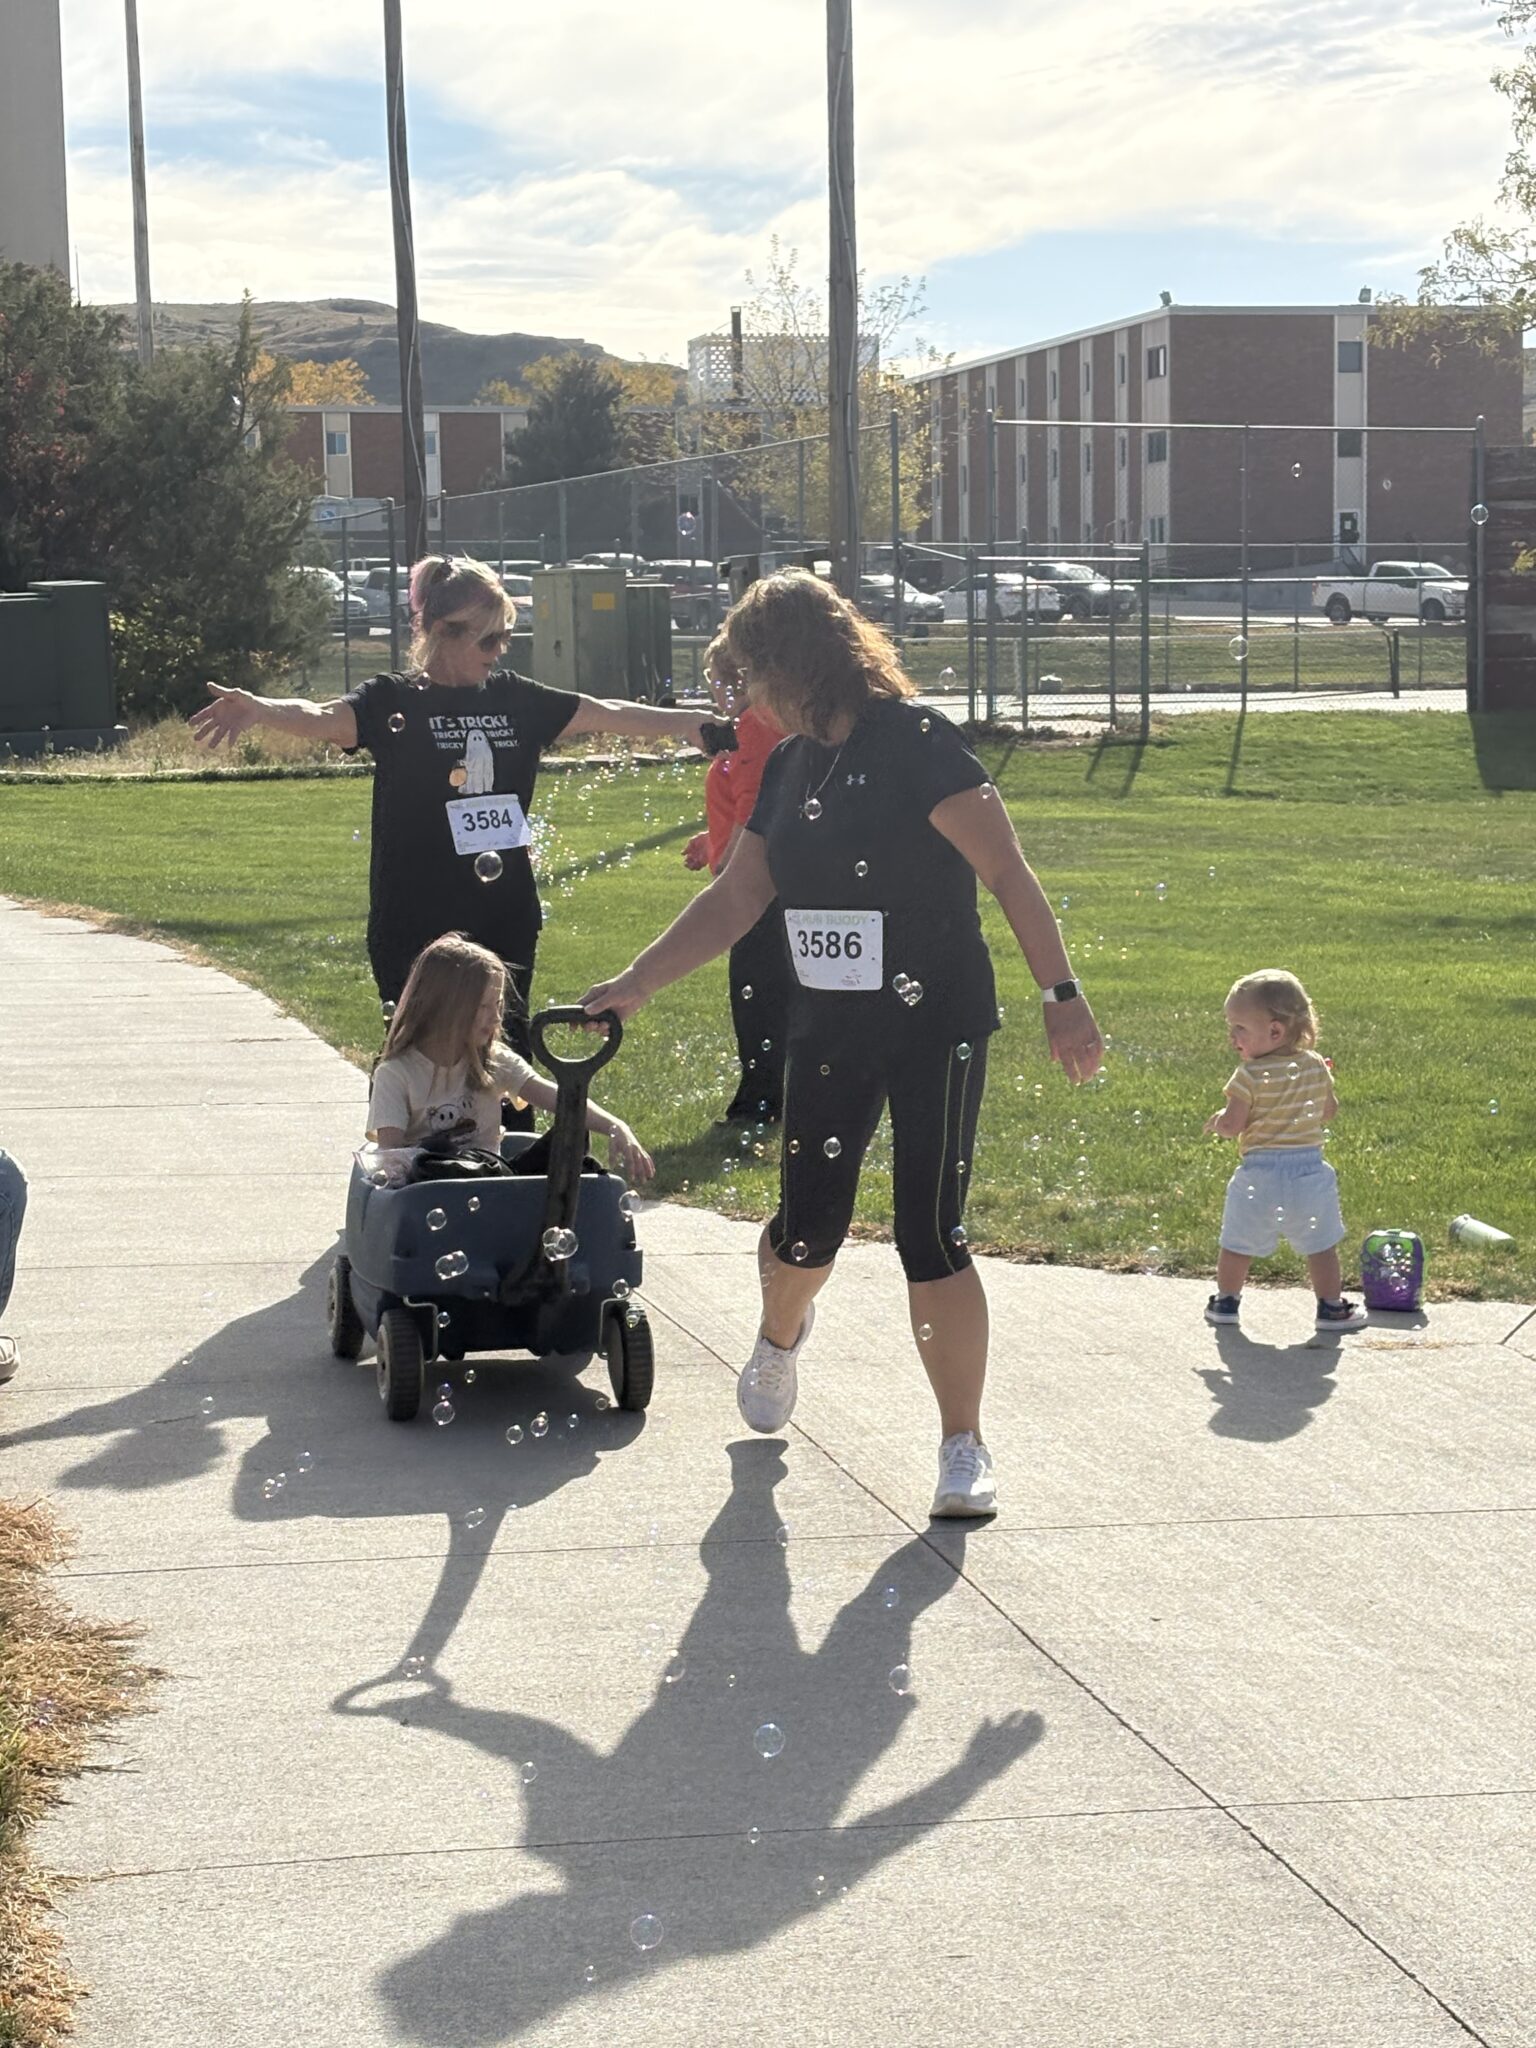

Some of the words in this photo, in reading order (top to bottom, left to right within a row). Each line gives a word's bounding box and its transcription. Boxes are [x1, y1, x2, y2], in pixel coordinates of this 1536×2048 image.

[457, 714, 508, 729] TRICKY
[433, 729, 467, 739] TRICKY
[462, 808, 513, 832] 3584
[826, 913, 868, 925] BUDDY
[797, 930, 863, 960] 3586
